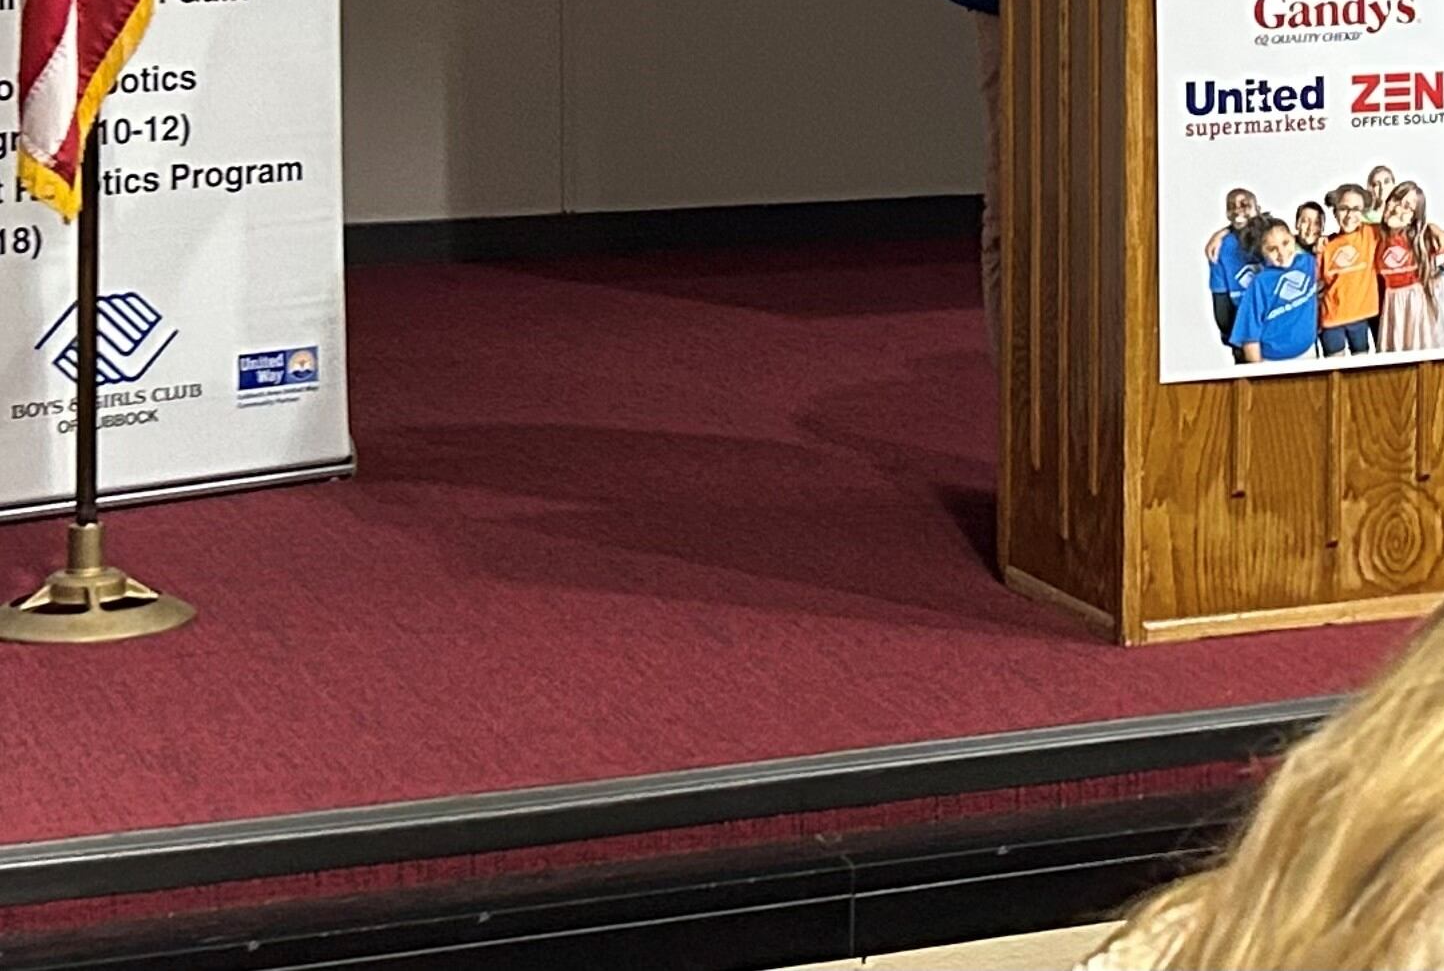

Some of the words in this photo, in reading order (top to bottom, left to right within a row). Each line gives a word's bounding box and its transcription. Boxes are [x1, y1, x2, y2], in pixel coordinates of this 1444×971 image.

[1271, 32, 1321, 45] QUALITY
[109, 66, 197, 96] otics
[1185, 76, 1325, 116] United
[99, 113, 191, 147] 10-12)
[1185, 115, 1326, 141] supermarkets
[1351, 114, 1399, 128] OFFICE
[170, 160, 303, 193] Program
[11, 399, 64, 419] BOYS
[151, 383, 203, 403] CLUB
